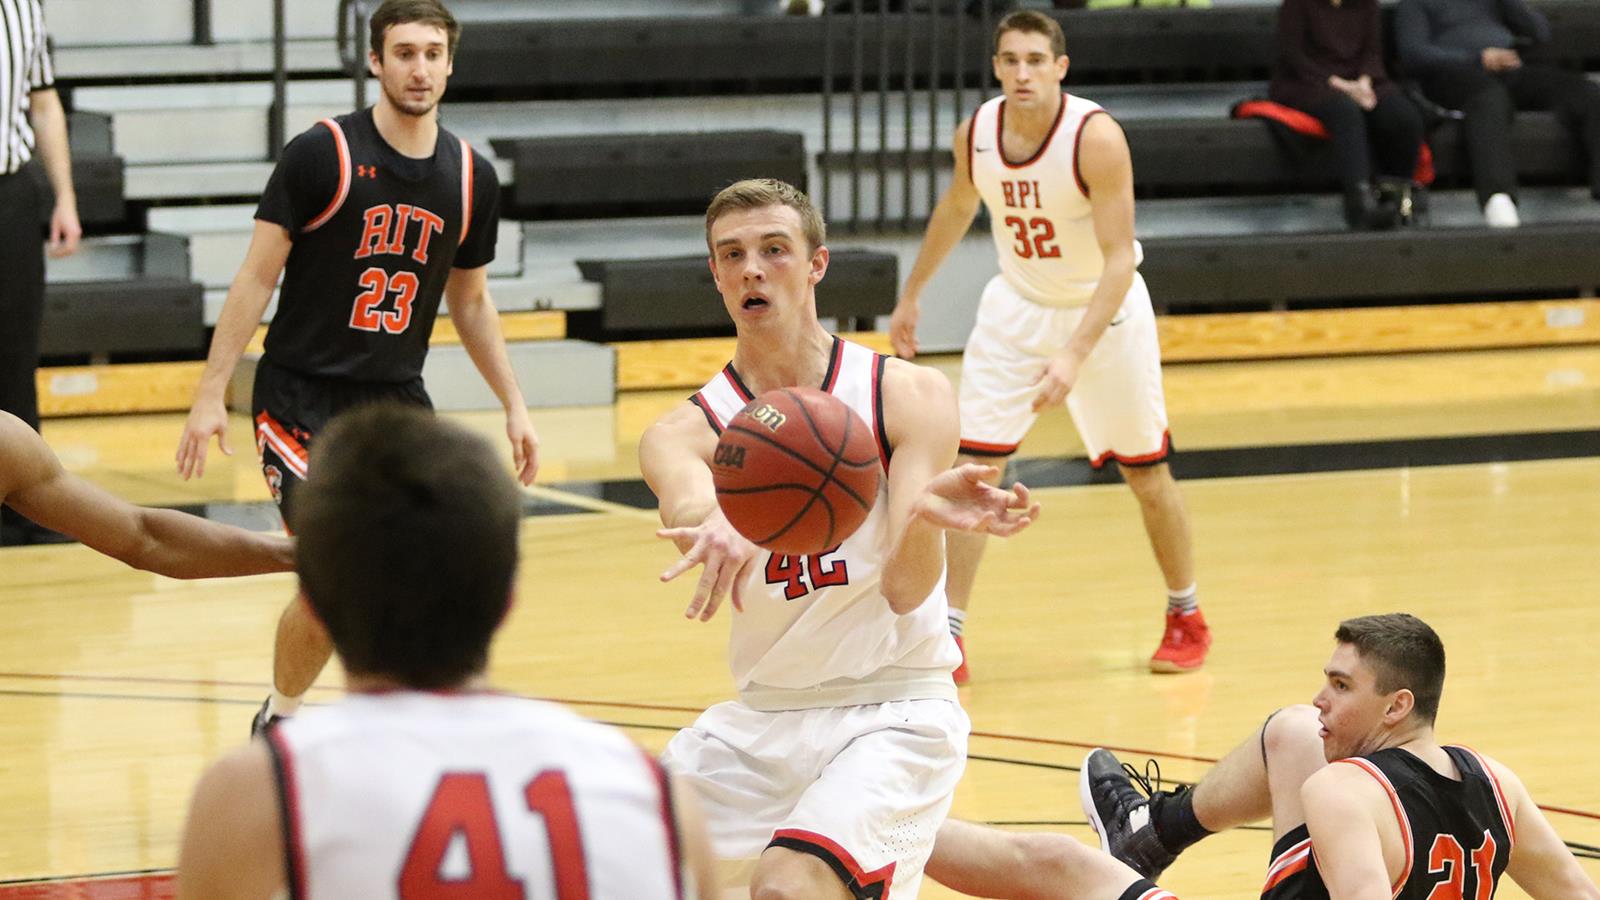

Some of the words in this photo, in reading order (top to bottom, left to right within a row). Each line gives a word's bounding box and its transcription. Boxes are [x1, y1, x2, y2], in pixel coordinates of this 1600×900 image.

[1001, 180, 1041, 209] RPI
[353, 203, 445, 265] RIT
[1005, 215, 1062, 259] 32
[349, 267, 420, 335] 23
[746, 403, 787, 433] on
[765, 543, 849, 601] 42
[397, 767, 592, 900] 41
[1425, 828, 1497, 900] 21
